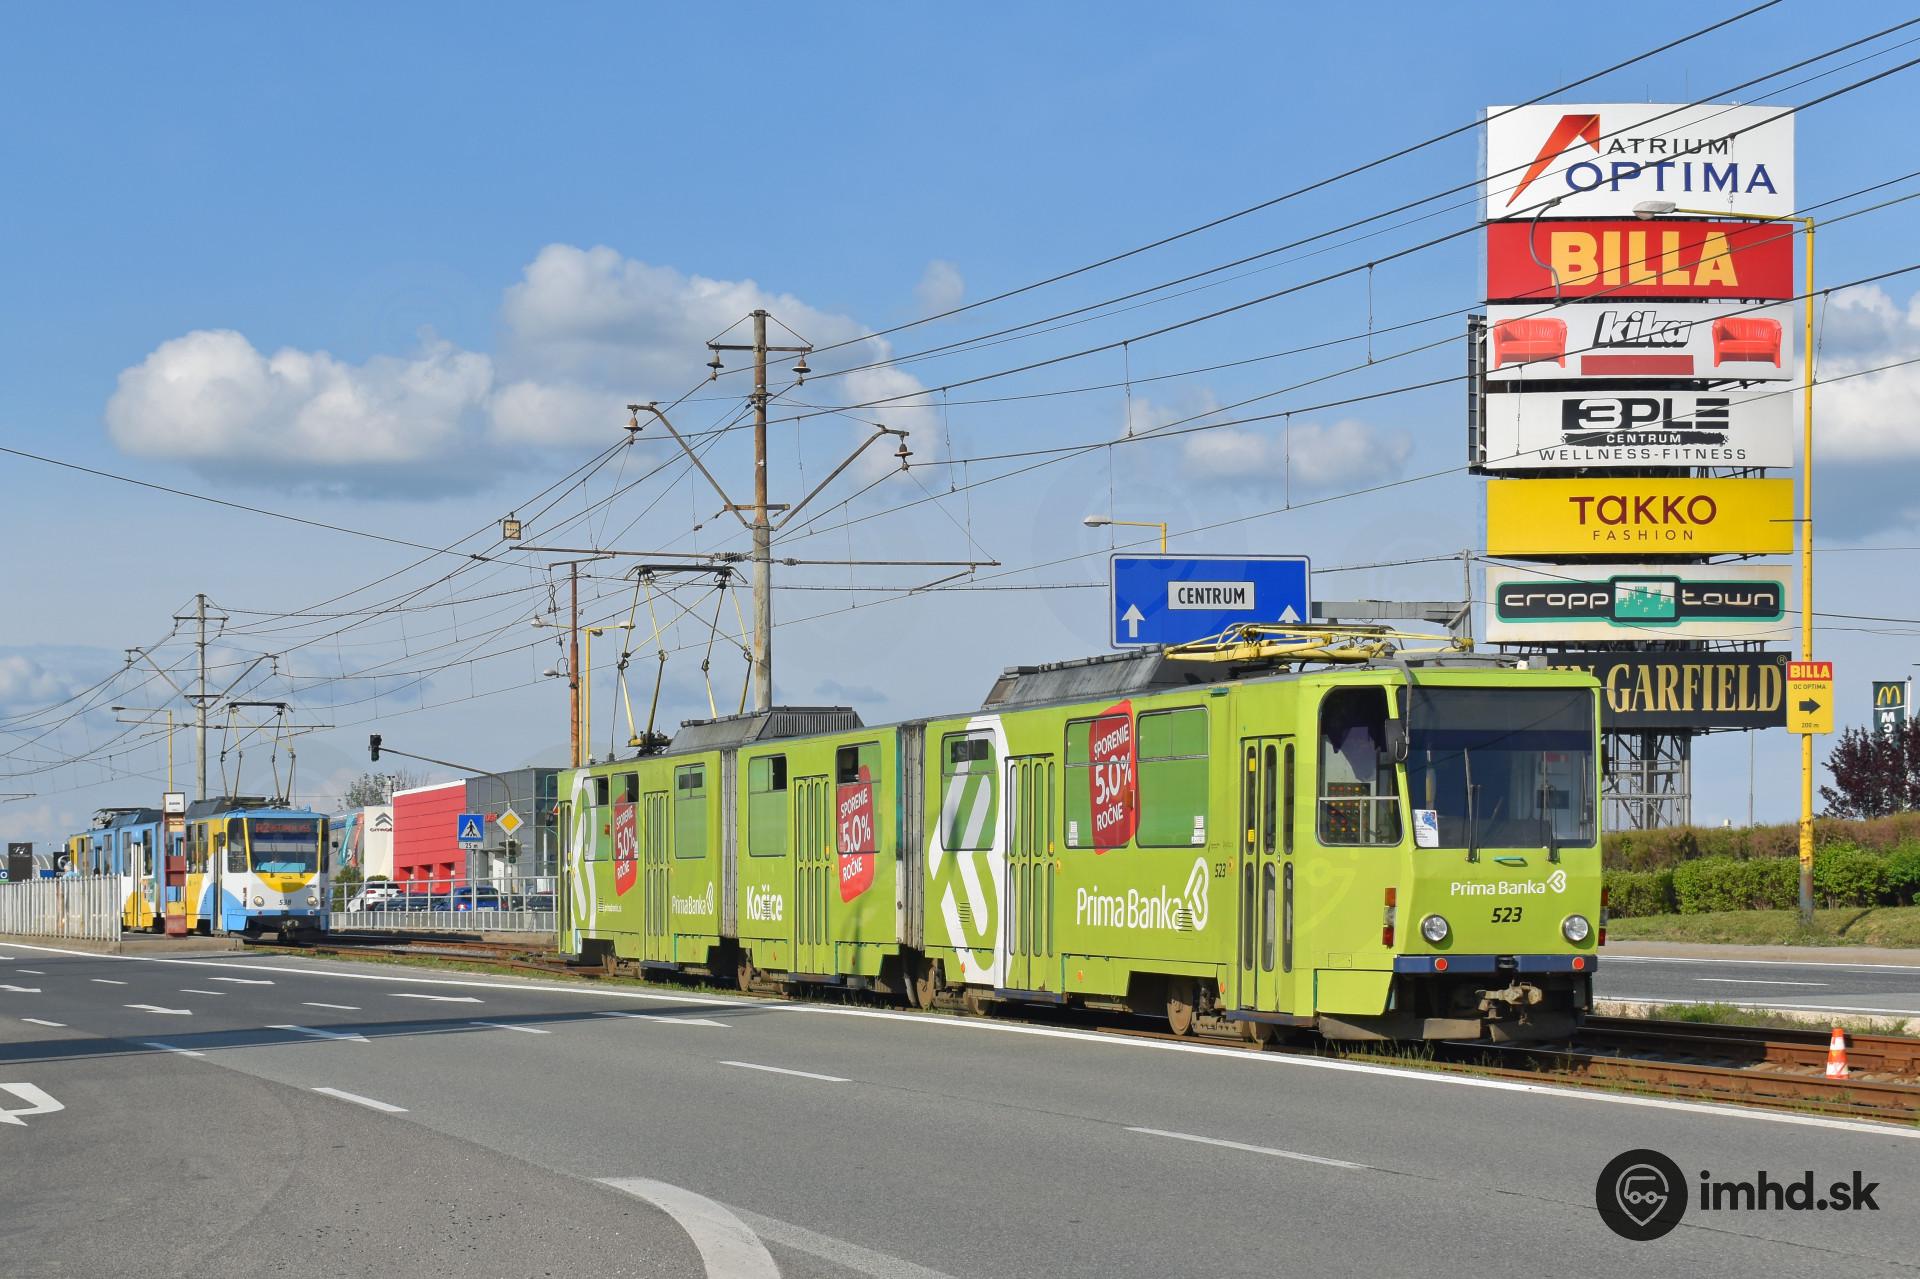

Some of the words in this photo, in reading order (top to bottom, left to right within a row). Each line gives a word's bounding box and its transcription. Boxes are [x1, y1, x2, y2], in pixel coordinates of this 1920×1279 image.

[1607, 138, 1729, 156] ATRIUM
[1565, 161, 1778, 195] OPTIMA
[1550, 230, 1739, 287] BILLA
[1591, 310, 1694, 349] kika
[1577, 397, 1730, 430] 3PLE
[1606, 433, 1682, 444] CENTRUM
[1538, 448, 1748, 461] WELLNESS-FITNESS
[1592, 530, 1695, 541] FASHION
[1177, 587, 1246, 605] CENTRUM
[1504, 592, 1609, 609] cropp
[1681, 588, 1775, 606] town
[1789, 664, 1831, 679] BILLA
[1606, 663, 1783, 713] GARFIELD
[1093, 723, 1130, 761] SPORENIE
[1095, 752, 1132, 805] 5,0%
[840, 787, 869, 819] SPORENIE
[1096, 801, 1124, 832] ROČNE
[842, 856, 863, 882] ROČNE
[1214, 863, 1226, 878] 523
[1450, 881, 1496, 896] Prima
[1498, 880, 1547, 895] Banka
[746, 884, 783, 921] Košice
[1076, 884, 1125, 928] Prima
[1127, 884, 1184, 932] Banka
[1490, 906, 1523, 923] 523
